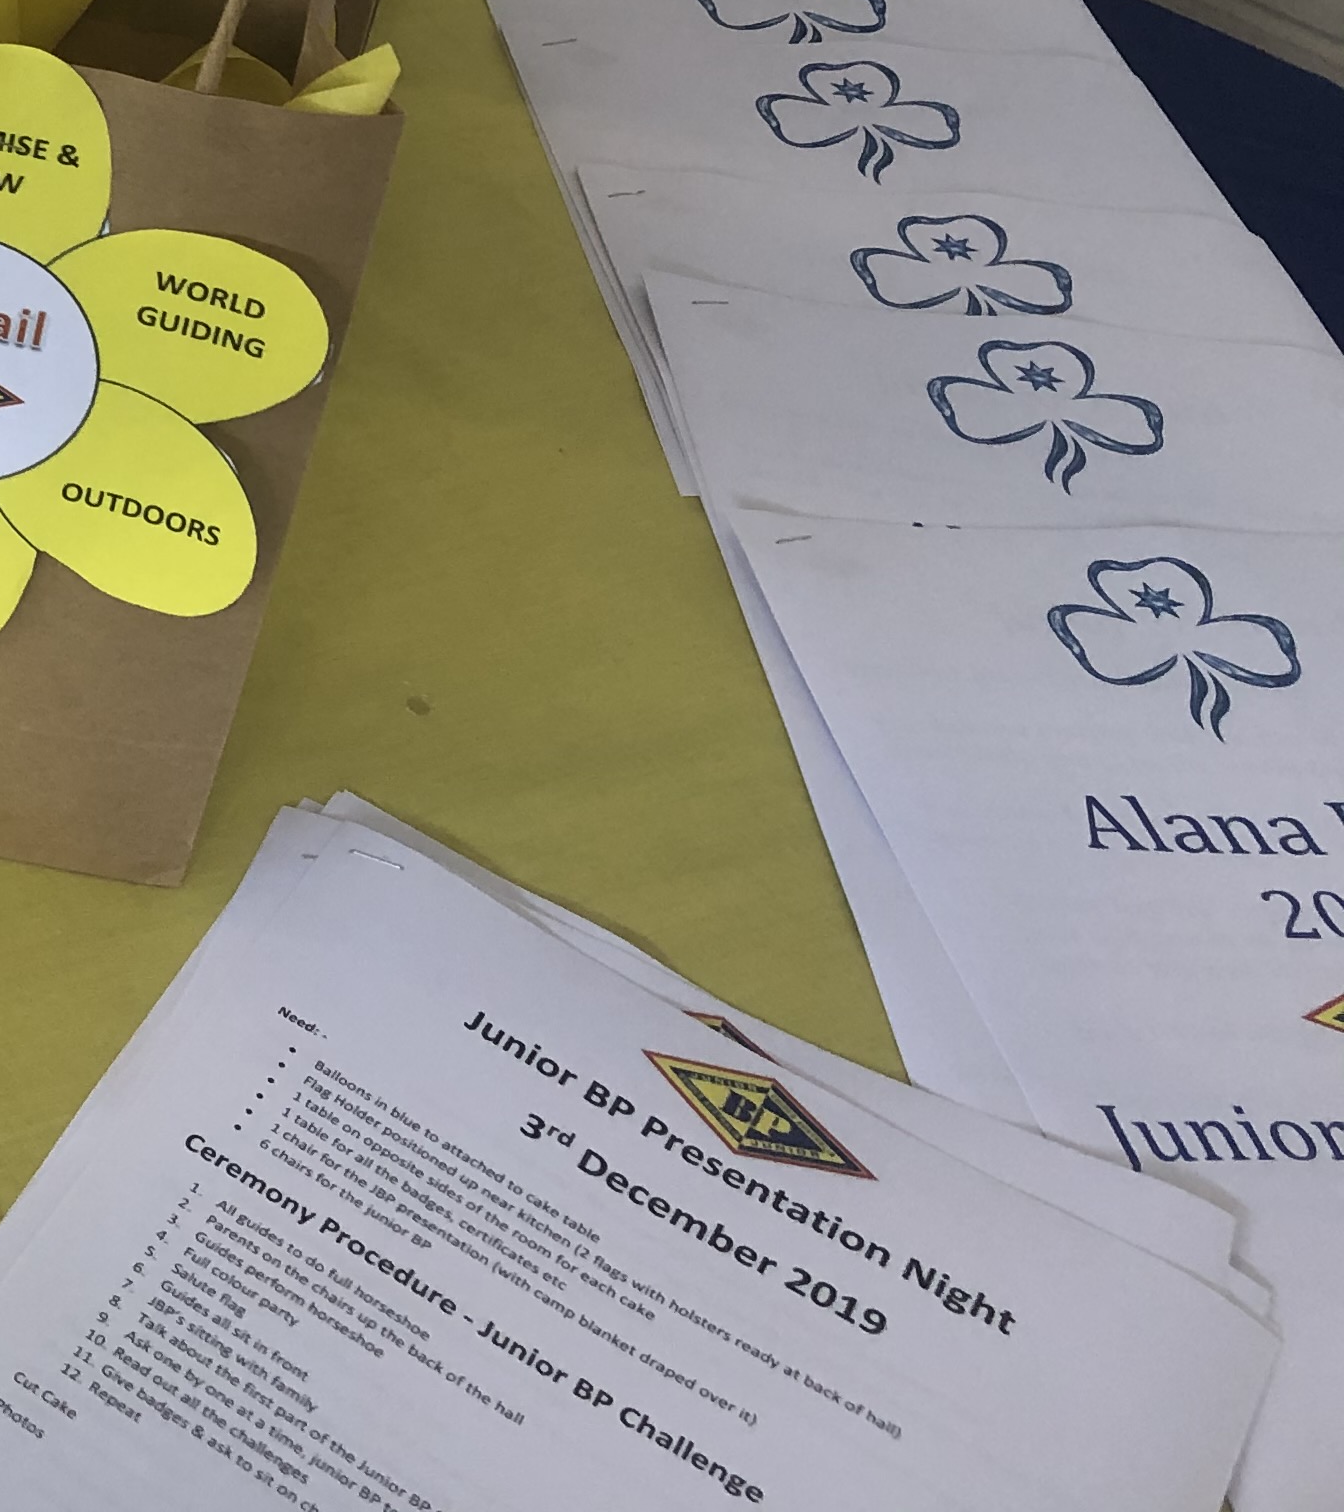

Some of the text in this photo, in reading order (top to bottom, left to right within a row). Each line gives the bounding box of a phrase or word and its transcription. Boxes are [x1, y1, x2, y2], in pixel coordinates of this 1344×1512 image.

[56, 144, 80, 169] &
[136, 306, 266, 359] GUIDING
[156, 271, 266, 319] WORLD
[61, 482, 221, 546] OUTDOORS
[1085, 795, 1329, 856] Alana
[276, 1005, 320, 1036] Need:
[313, 1058, 601, 1244] Balloons blue attached cake table
[721, 1089, 792, 1137] BP
[1096, 1105, 1344, 1173] Junior
[270, 1147, 432, 1249] chairs junior BP
[293, 1113, 329, 1142] table
[457, 1218, 539, 1275] certificates
[541, 1271, 567, 1291] etc
[303, 1098, 656, 1321] table opposite sides room each cake
[462, 1010, 1017, 1336] Junior BP Presentation Night
[169, 1261, 247, 1319] Salute flag
[182, 1245, 300, 1328] Full colour party
[214, 1199, 431, 1342] All guides full horseshoe
[281, 1130, 319, 1156] chair
[367, 1183, 397, 1203] JBP
[394, 1202, 489, 1266] presentation
[490, 1260, 531, 1292] (with
[532, 1288, 576, 1320] camp
[577, 1313, 637, 1357] blanket
[638, 1352, 697, 1391] draped
[697, 1386, 737, 1412] over
[302, 1074, 332, 1100] Flag
[332, 1093, 382, 1129] Holder
[379, 1125, 459, 1177] positioned
[479, 1186, 516, 1212] near
[515, 1207, 571, 1248] kitchen
[572, 1242, 590, 1260] (2
[592, 1254, 628, 1283] flags
[630, 1278, 666, 1305] with
[667, 1297, 731, 1342] holsters
[733, 1337, 780, 1369] ready
[802, 1373, 842, 1405] back
[576, 1147, 778, 1276] December
[783, 1266, 887, 1335] 2019
[159, 1278, 309, 1383] Guides front
[184, 1133, 764, 1504] Ceremony Procedure Junior BP Challenge
[194, 1230, 384, 1359] Guides perform horseshoe
[204, 1213, 525, 1426] Parents chairs back hall
[12, 1370, 77, 1420] Cut Cake
[87, 1379, 142, 1424] Repeat
[100, 1363, 190, 1430] Give badges
[111, 1345, 309, 1485] Read challenges
[122, 1330, 152, 1354] Ask
[306, 1454, 358, 1490] junior
[357, 1484, 382, 1504] BP
[137, 1310, 432, 1511] Talk about first part Junior BP
[185, 1321, 234, 1359] sitting
[234, 1353, 268, 1381] with
[269, 1374, 319, 1414] family
